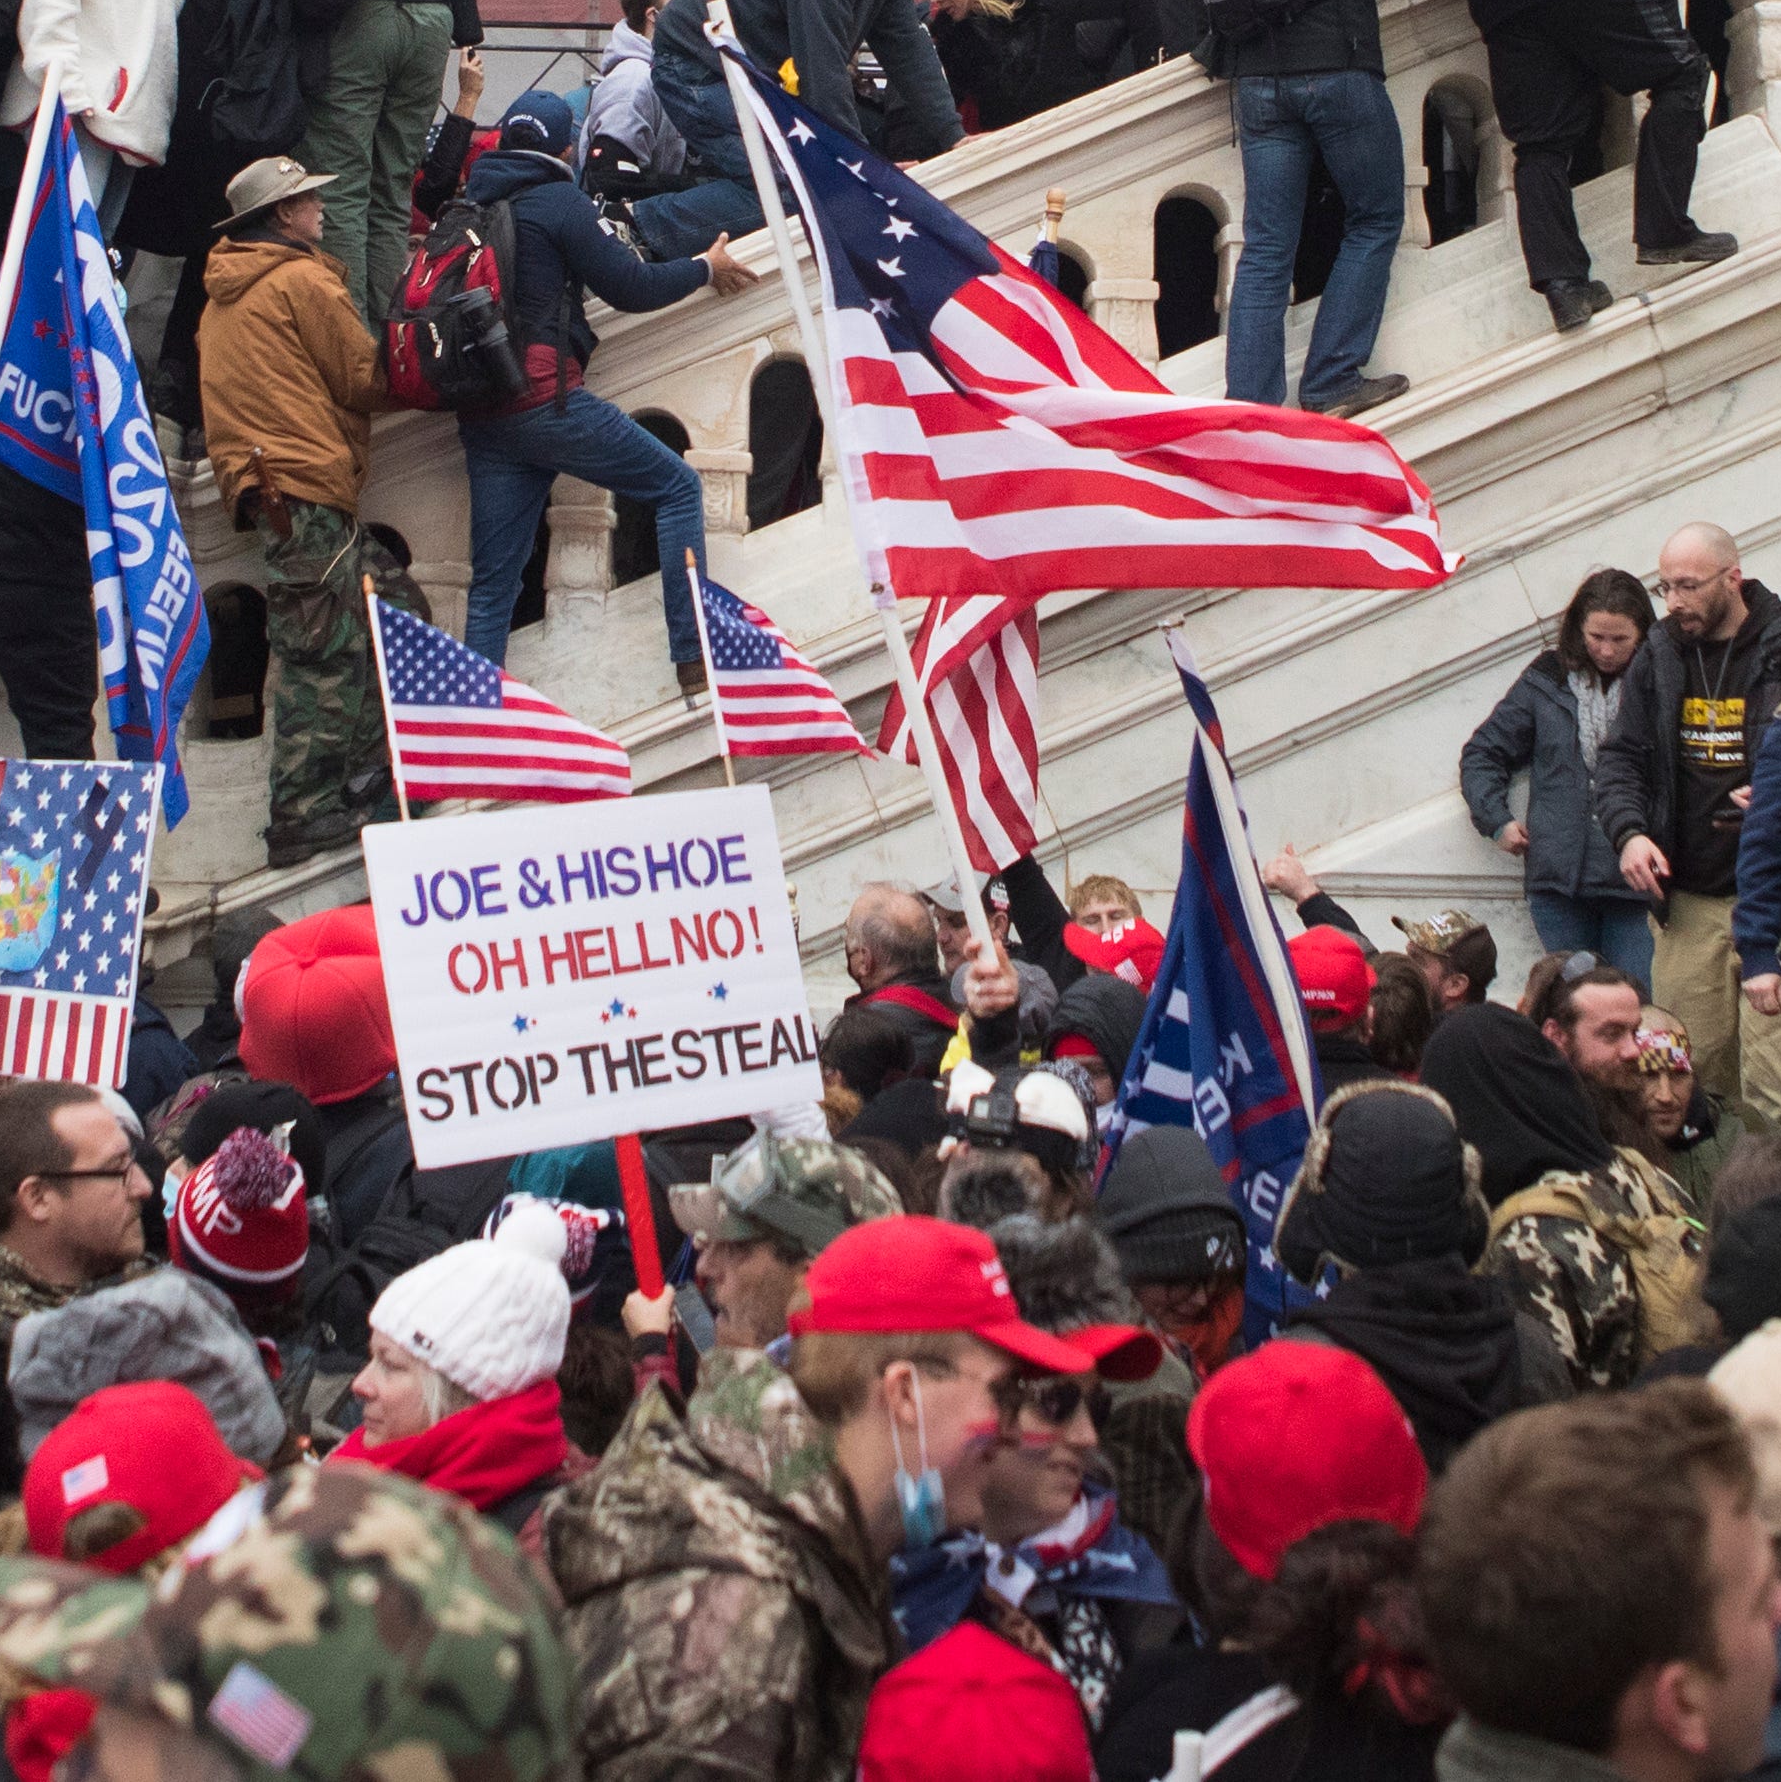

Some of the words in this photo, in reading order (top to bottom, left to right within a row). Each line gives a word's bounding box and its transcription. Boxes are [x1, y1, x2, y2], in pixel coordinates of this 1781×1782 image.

[400, 863, 508, 928] JOE
[518, 858, 556, 910] &
[447, 937, 530, 996] OH
[539, 925, 671, 986] HELL
[416, 1049, 559, 1124] STOP
[567, 1029, 672, 1098] THE
